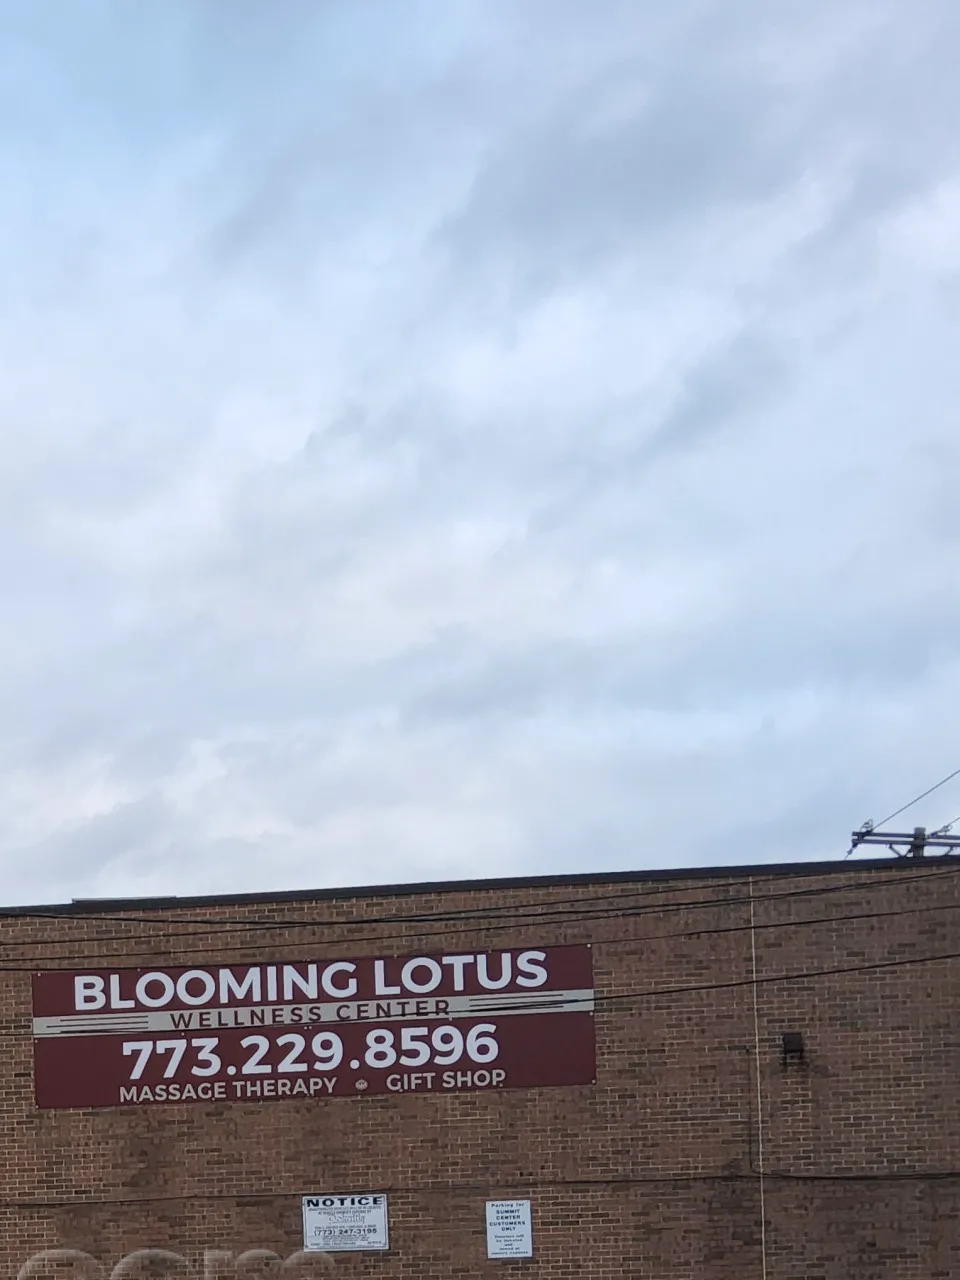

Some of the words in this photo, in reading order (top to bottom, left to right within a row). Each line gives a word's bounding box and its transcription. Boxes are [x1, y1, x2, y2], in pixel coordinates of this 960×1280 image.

[74, 961, 358, 1011] BLOOMING
[374, 950, 548, 996] LOTUS
[170, 1005, 322, 1029] WELLNESS
[336, 999, 450, 1020] CENTER
[122, 1023, 499, 1080] 773.229.8596
[119, 1082, 227, 1103] MASSAGE
[232, 1076, 338, 1098] THERAPY
[386, 1072, 436, 1091] GIFT
[442, 1069, 506, 1088] SHOP
[307, 1197, 383, 1207] NOTICE
